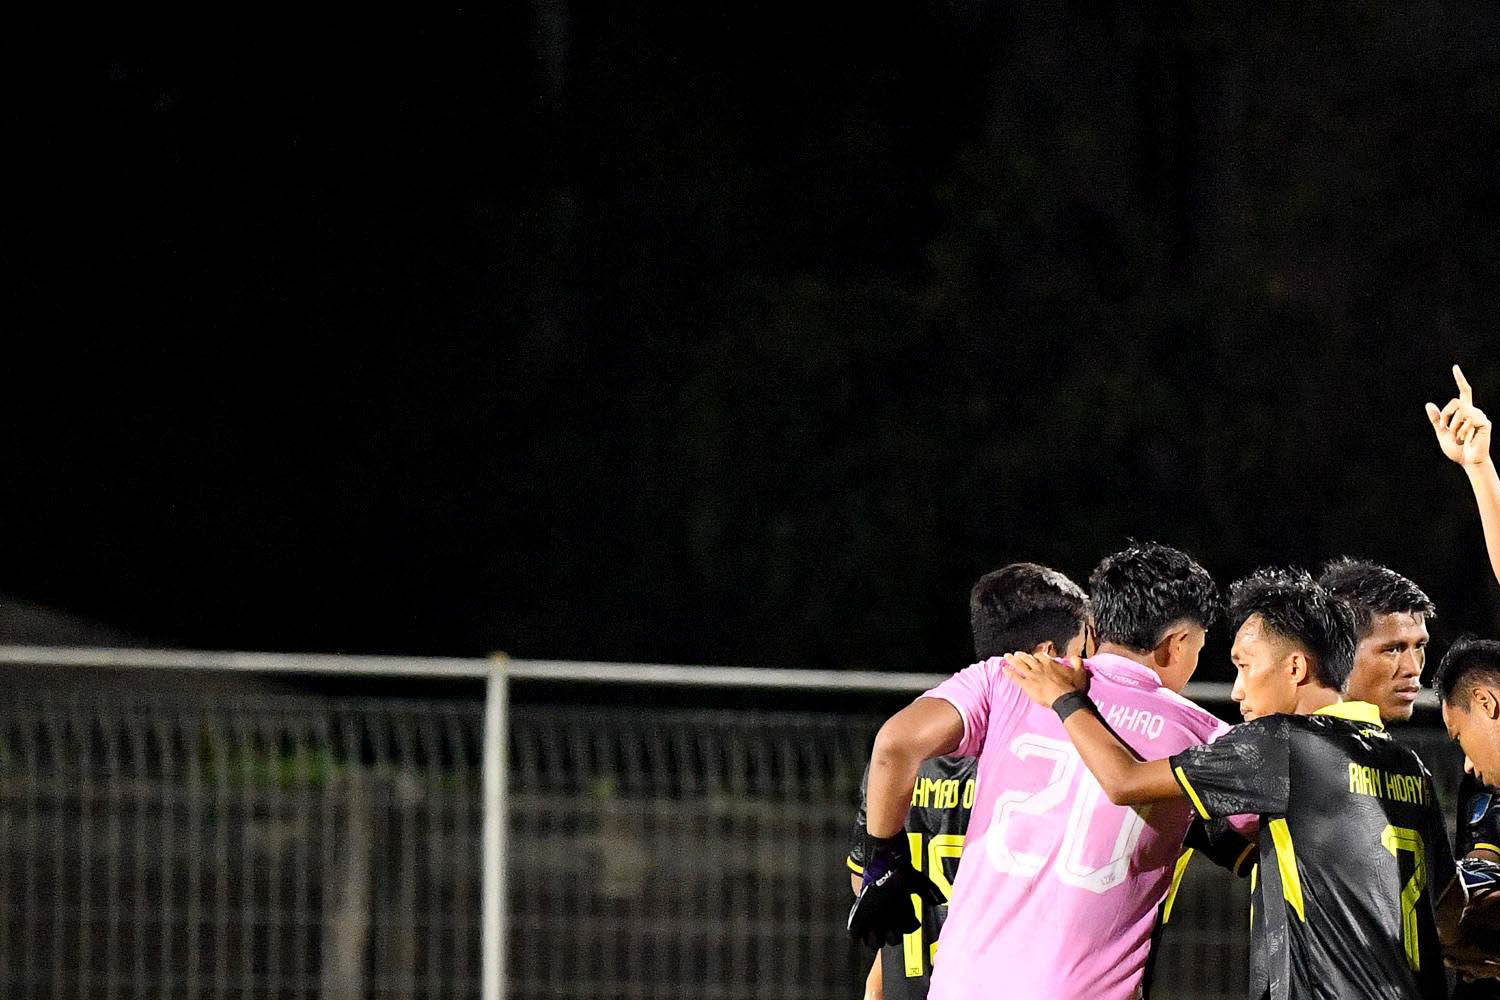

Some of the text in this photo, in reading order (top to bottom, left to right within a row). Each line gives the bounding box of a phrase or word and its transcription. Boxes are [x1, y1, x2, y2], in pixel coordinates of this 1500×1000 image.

[911, 776, 960, 810] HMAD
[986, 732, 1147, 894] 20
[1386, 771, 1427, 806] HIDAY
[1381, 824, 1426, 973] 7
